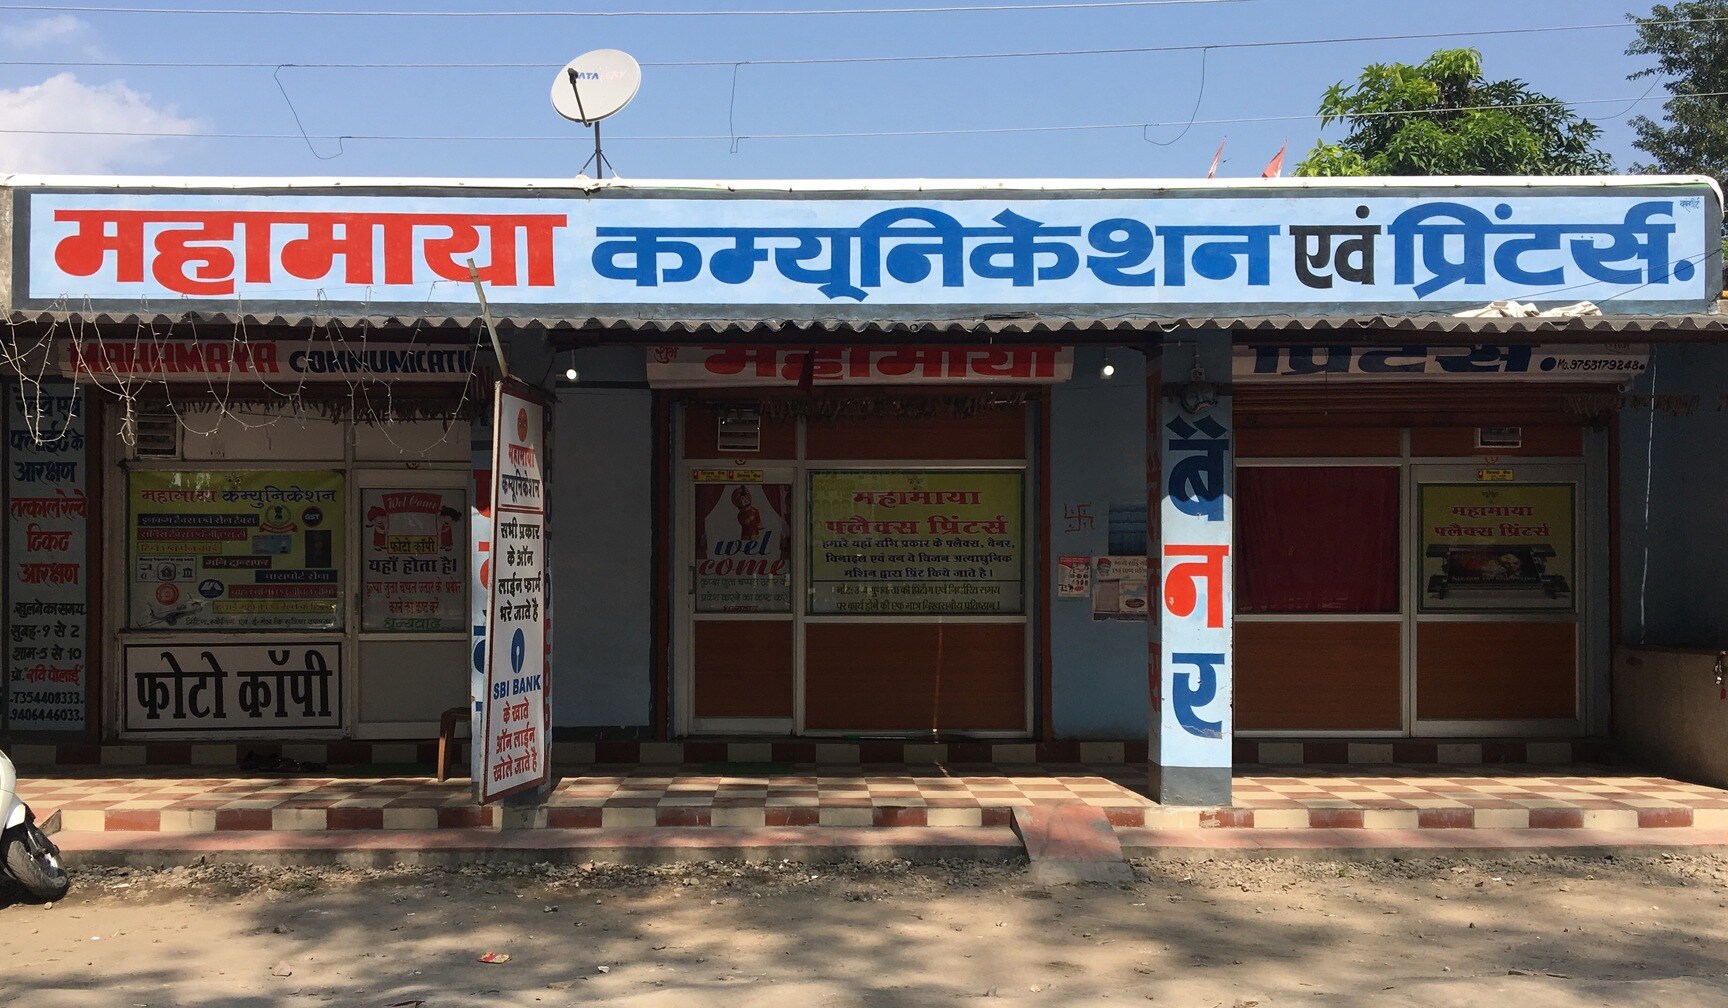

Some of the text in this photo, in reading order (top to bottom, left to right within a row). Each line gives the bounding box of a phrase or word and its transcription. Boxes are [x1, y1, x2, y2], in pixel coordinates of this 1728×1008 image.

[54, 210, 568, 294] महामाया
[591, 206, 1280, 302] कम्यूनिकेशन
[1290, 205, 1381, 288] एवं
[69, 342, 280, 373] MAHAMAYA
[704, 344, 1061, 381] महामाया
[508, 444, 534, 469] महामाया
[14, 461, 77, 486] आरक्षण
[854, 492, 982, 508] महामाया
[1450, 506, 1533, 518] महामाया
[26, 522, 72, 552] टिकट
[500, 516, 540, 540] सभी प्रकार
[826, 515, 1008, 535] फ्लैक्स प्रिंटर्स
[1434, 522, 1552, 538] फ्लैक्स प्रिंटर्स
[390, 538, 435, 552] फोटो कॉपी
[714, 530, 772, 556] wel
[822, 538, 848, 549] हमारे
[901, 540, 929, 548] प्रकार
[932, 538, 942, 548] के
[368, 556, 398, 574] यहाँ
[403, 556, 438, 574] होता
[507, 545, 534, 567] के ऑन
[700, 558, 790, 576] come
[870, 554, 884, 564] एवं
[908, 553, 916, 562] वे
[918, 553, 950, 562] विजन
[954, 553, 1012, 566] अत्याधुनिक
[18, 563, 80, 587] आरक्षण
[498, 571, 542, 597] लाईन फार्म
[844, 569, 876, 578] मशिन
[880, 570, 903, 579] द्वारा
[906, 568, 926, 578] प्रिंट
[928, 568, 950, 578] किये
[954, 569, 976, 578] जाते
[500, 600, 512, 622] भरे
[514, 598, 531, 620] जाते
[54, 620, 66, 638] से
[70, 625, 80, 638] 2
[52, 644, 64, 660] से
[67, 648, 82, 660] 10
[135, 650, 332, 720] फोटो कॉपी
[494, 674, 541, 700] SBI BANK
[502, 696, 530, 724] के खाते
[496, 722, 536, 754] ऑन लाईन
[493, 754, 513, 782] खोले
[514, 751, 531, 774] जाते
